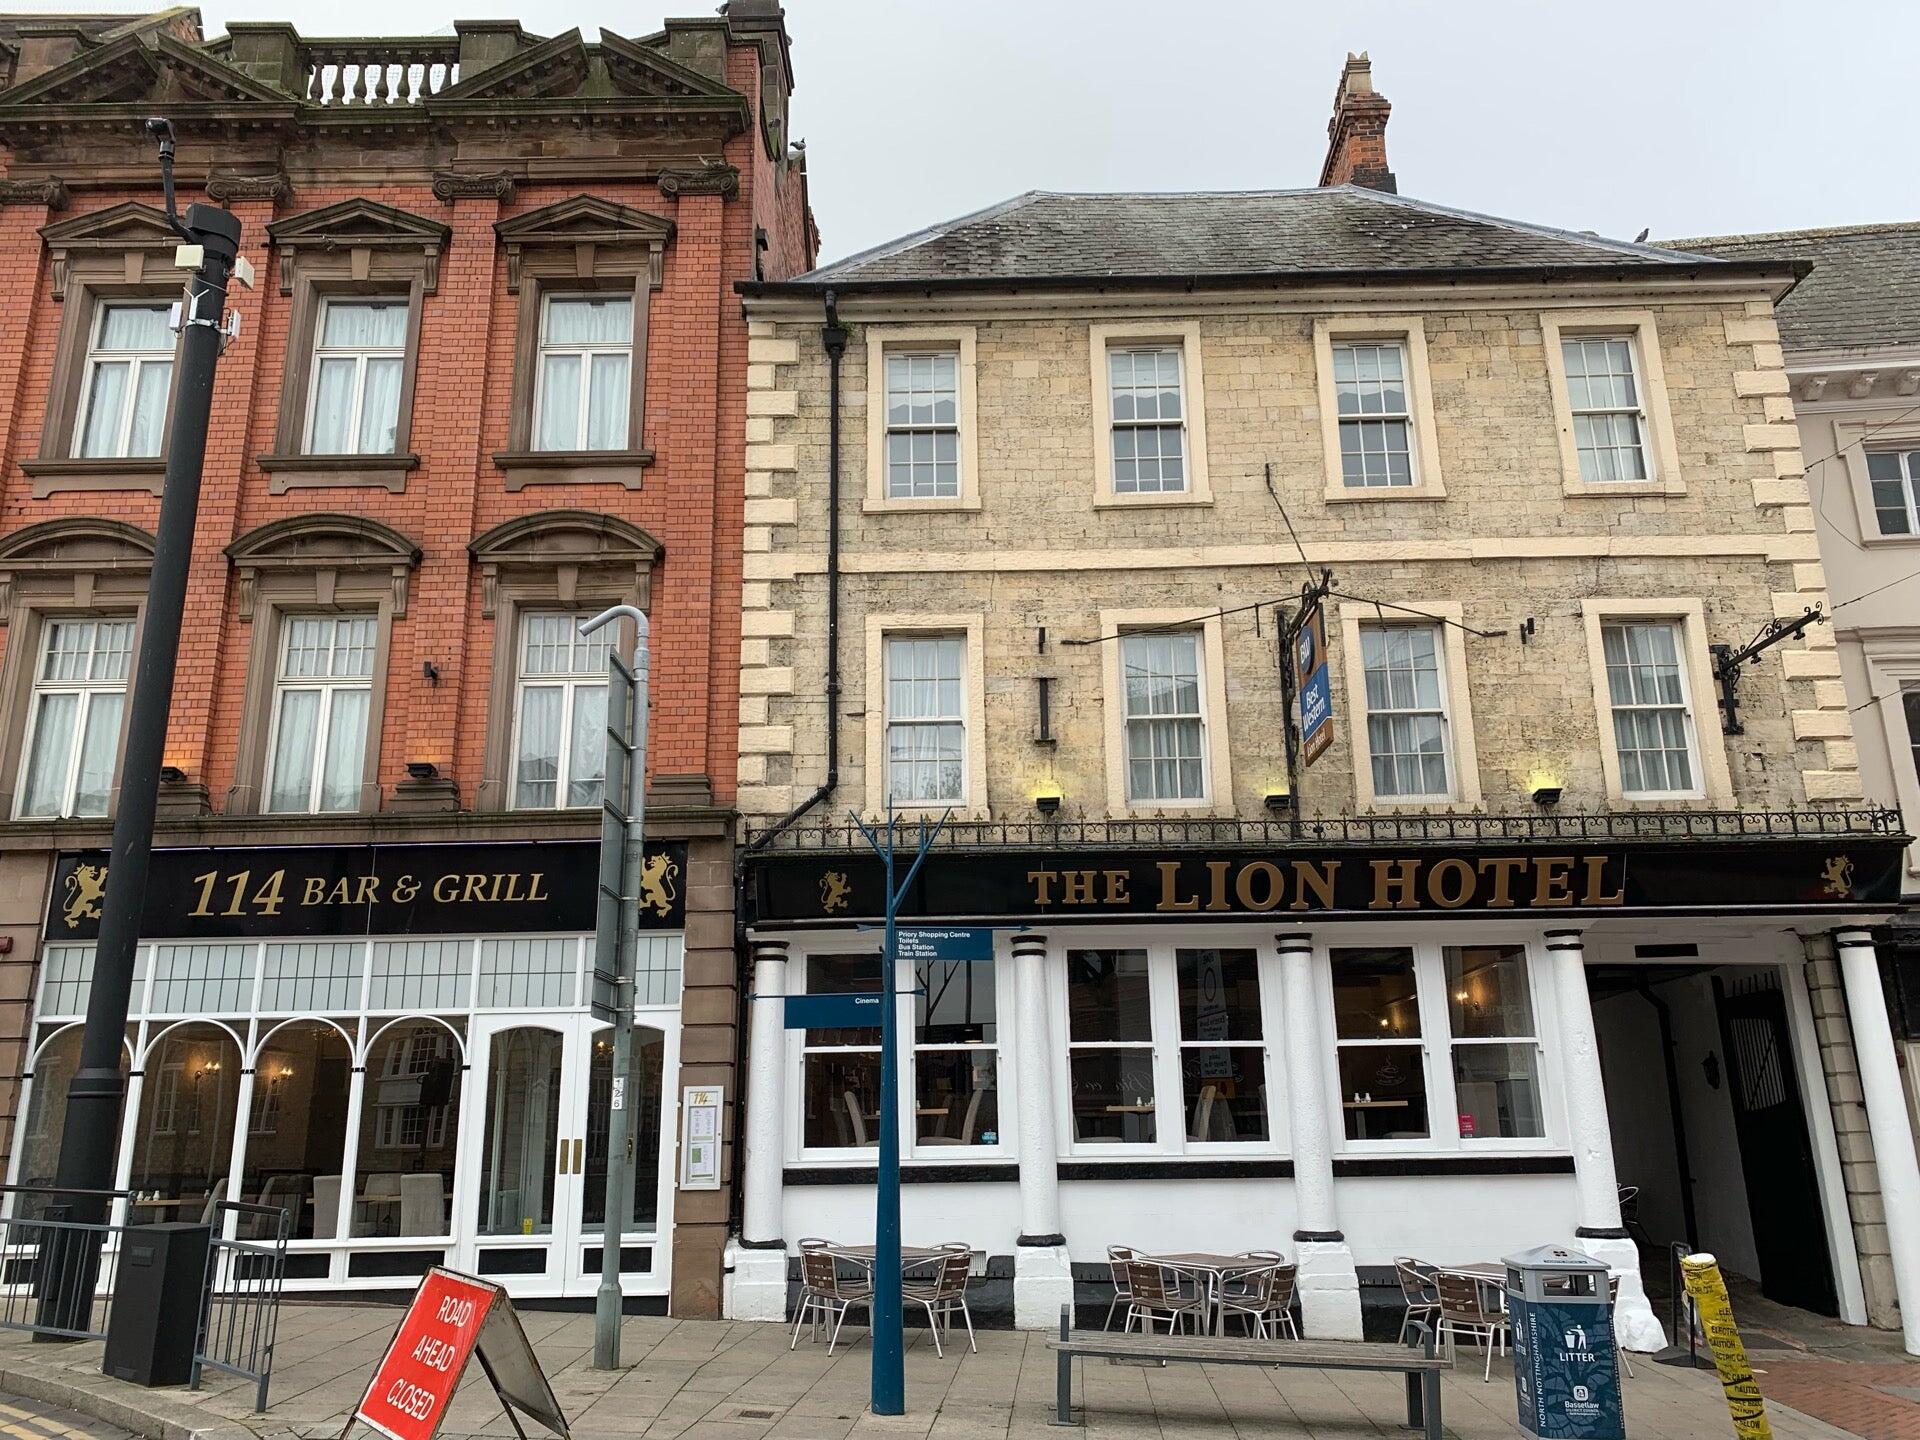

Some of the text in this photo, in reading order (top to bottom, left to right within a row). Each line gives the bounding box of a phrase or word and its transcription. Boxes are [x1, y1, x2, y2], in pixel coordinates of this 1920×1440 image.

[1306, 684, 1318, 709] Best
[1303, 697, 1325, 732] Western
[187, 869, 549, 917] 114 BAR & GRILL
[1027, 855, 1625, 912] THE LION HOTEL
[898, 931, 918, 939] Priory
[918, 931, 948, 939] Shopping
[436, 1295, 473, 1328] ROAD
[411, 1334, 456, 1372] AHEAD
[1529, 1312, 1546, 1427] NORTH NOTTINGHAMSHIRE
[1559, 1352, 1596, 1362] LITTER
[386, 1378, 436, 1421] CLOSED
[1564, 1400, 1600, 1409] Bassetlaw
